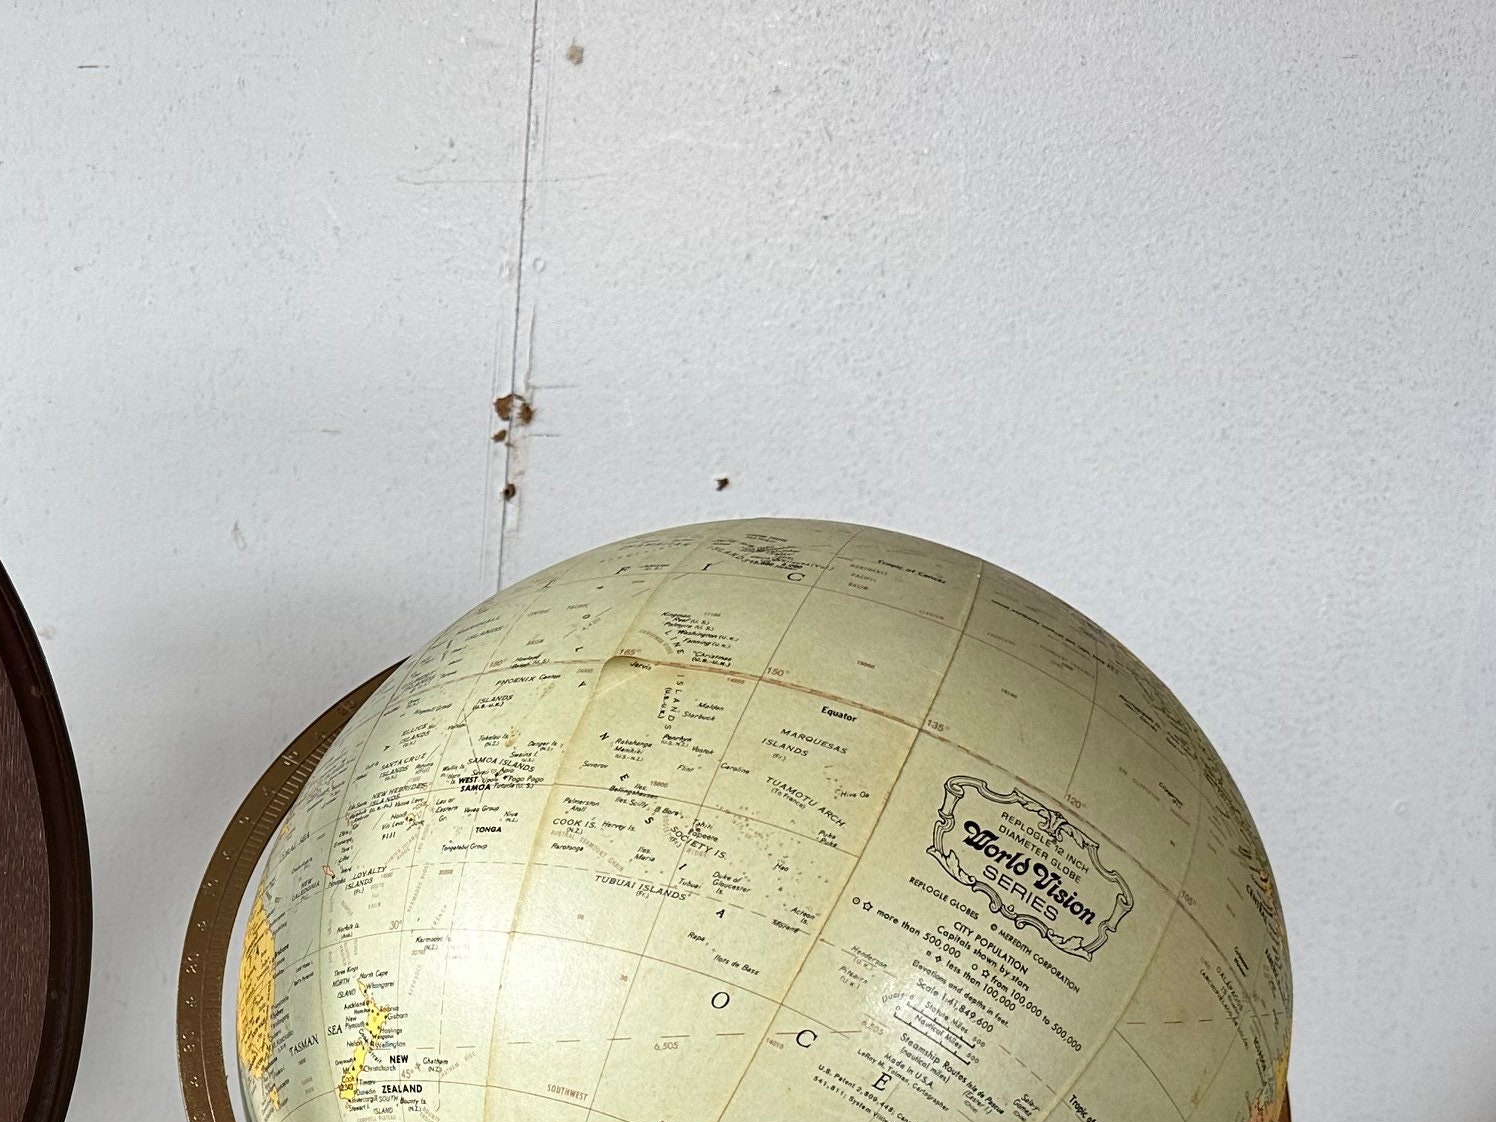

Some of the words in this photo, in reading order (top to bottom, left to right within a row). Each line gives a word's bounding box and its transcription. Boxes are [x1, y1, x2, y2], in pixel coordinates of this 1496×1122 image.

[821, 705, 857, 722] Equator
[762, 737, 809, 757] ISLANDS
[780, 728, 848, 755] MARQUESAS
[499, 759, 535, 772] ISLANDS
[720, 762, 750, 775] Caroline
[458, 776, 478, 784] WEST
[460, 783, 490, 792] SAMOA
[766, 776, 817, 807] TUAMOTU
[553, 818, 582, 826] COOK
[584, 820, 597, 828] IS.
[670, 826, 713, 853] SOCIETY
[1001, 812, 1052, 847] REPLOGLE
[1053, 844, 1065, 856] 12
[1066, 853, 1089, 874] INCH
[998, 824, 1049, 861] DIAMETER
[1050, 858, 1081, 884] GLOBE
[352, 865, 387, 881] LOYALTY
[712, 871, 732, 882] Duke
[963, 821, 1031, 876] World
[1033, 862, 1096, 925] Vision
[594, 875, 636, 890] TUBUAI
[639, 883, 687, 901] ISLANDS
[712, 879, 751, 895] Gloucester
[909, 876, 949, 902] REPLOGLE
[949, 898, 979, 920] GLOBES
[983, 864, 1059, 921] SERIES
[687, 931, 706, 942] Rapa
[876, 909, 899, 925] more
[900, 921, 920, 936] than
[922, 933, 961, 958] 500,000
[850, 945, 888, 969] Henderson
[937, 925, 972, 950] Capitals
[973, 948, 998, 966] shown
[998, 964, 1010, 977] by
[1012, 973, 1030, 992] stars
[953, 921, 974, 937] CITY
[975, 934, 1028, 975] POPULATION
[741, 964, 760, 976] Bass
[998, 929, 1032, 955] MEREDITH
[1032, 953, 1080, 994] CORPORATION
[912, 959, 947, 984] Elevations
[948, 981, 962, 994] and
[963, 991, 986, 1011] depths
[987, 1006, 994, 1015] in
[916, 978, 939, 997] Scale
[946, 960, 961, 974] less
[963, 971, 980, 988] than
[983, 982, 1016, 1012] 100,000
[924, 1001, 949, 1021] Statute
[950, 1018, 969, 1034] Miles
[991, 975, 1008, 994] from
[1010, 986, 1042, 1018] 100,000
[1042, 1014, 1050, 1025] to
[1051, 1022, 1082, 1052] 500,000
[327, 1024, 343, 1036] SEA
[914, 1014, 944, 1036] Nautical
[944, 1031, 962, 1050] Miles
[288, 1034, 319, 1057] TASMAN
[900, 1032, 940, 1064] Steamship
[942, 1060, 967, 1083] Routes
[389, 1055, 409, 1064] NEW
[883, 1052, 904, 1070] Made
[906, 1066, 914, 1074] in
[914, 1071, 934, 1089] U.S.A.
[900, 1047, 929, 1072] (nautical
[930, 1065, 951, 1084] miles)
[381, 1084, 423, 1094] ZEALAND
[818, 1064, 832, 1074] U.S.
[834, 1072, 856, 1090] Patent
[857, 1048, 877, 1065] LeRoy
[878, 1061, 885, 1069] M.
[911, 1083, 950, 1112] Cartographer
[546, 1084, 588, 1101] SOUTHWEST
[848, 1095, 872, 1114] System
[1069, 1095, 1088, 1120] Tropic
